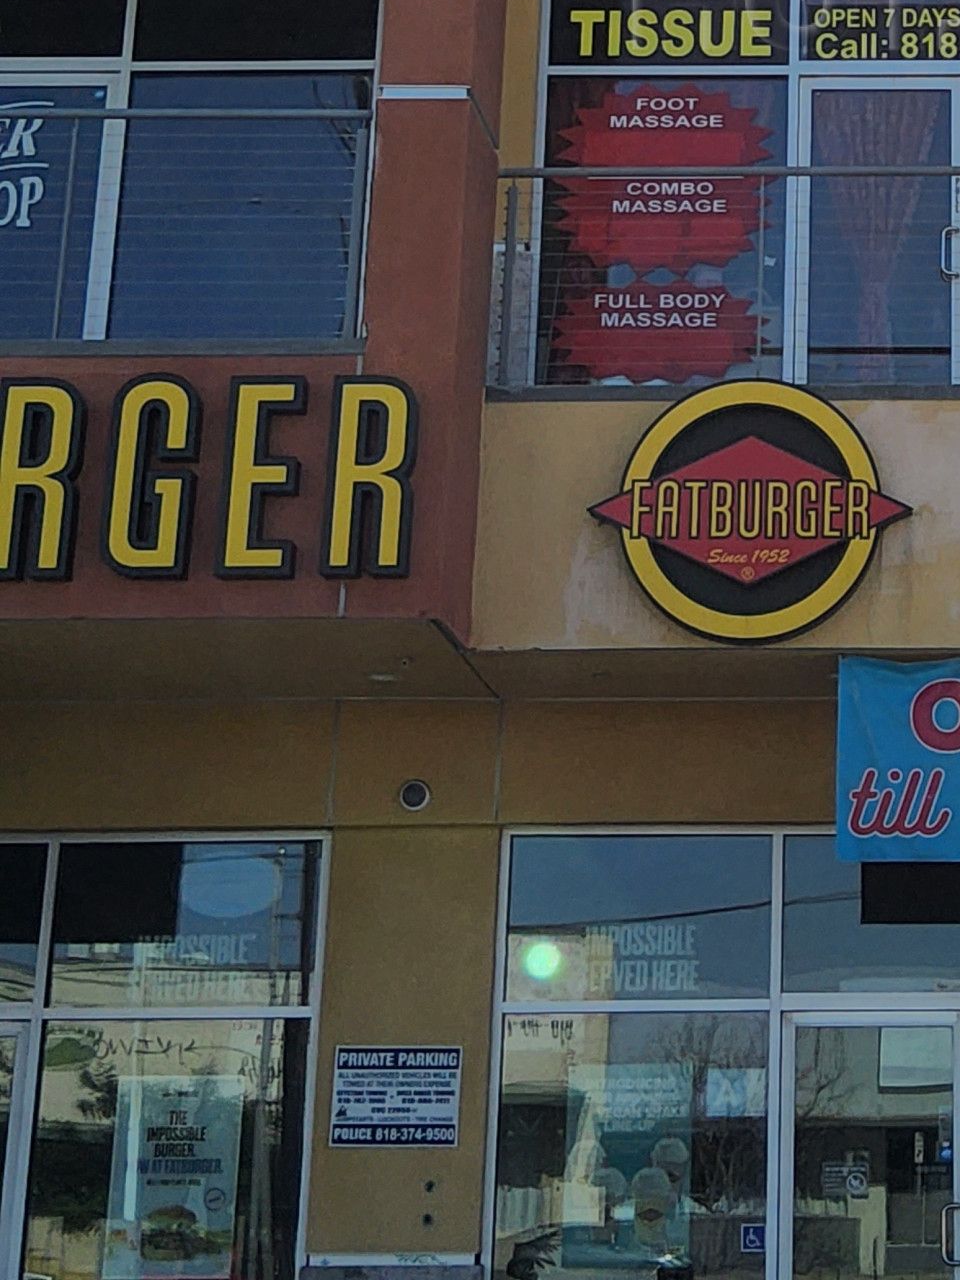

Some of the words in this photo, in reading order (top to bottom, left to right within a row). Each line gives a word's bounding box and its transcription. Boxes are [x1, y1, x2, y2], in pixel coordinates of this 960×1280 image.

[813, 8, 876, 27] OPEN
[882, 8, 895, 27] 7
[570, 9, 773, 57] TISSUE
[815, 32, 889, 59] Call:
[636, 98, 698, 111] FOOT
[609, 115, 724, 129] MASSAGE
[626, 182, 714, 196] COMBO
[612, 199, 727, 213] MASSAGE
[594, 294, 652, 309] FULL
[659, 294, 726, 309] BODY
[601, 313, 718, 328] MASSAGE
[0, 377, 413, 575] RGER
[629, 479, 872, 540] FATBURGER
[707, 548, 748, 564] Since
[751, 548, 790, 563] 1952
[847, 766, 953, 838] till
[579, 959, 650, 993] ERVED
[652, 959, 701, 992] HERE
[338, 1052, 395, 1067] PRIVATE
[398, 1052, 458, 1067] PARKING
[168, 1110, 189, 1126] THE
[333, 1127, 373, 1140] POLICE
[375, 1127, 455, 1141] 818-374-9500
